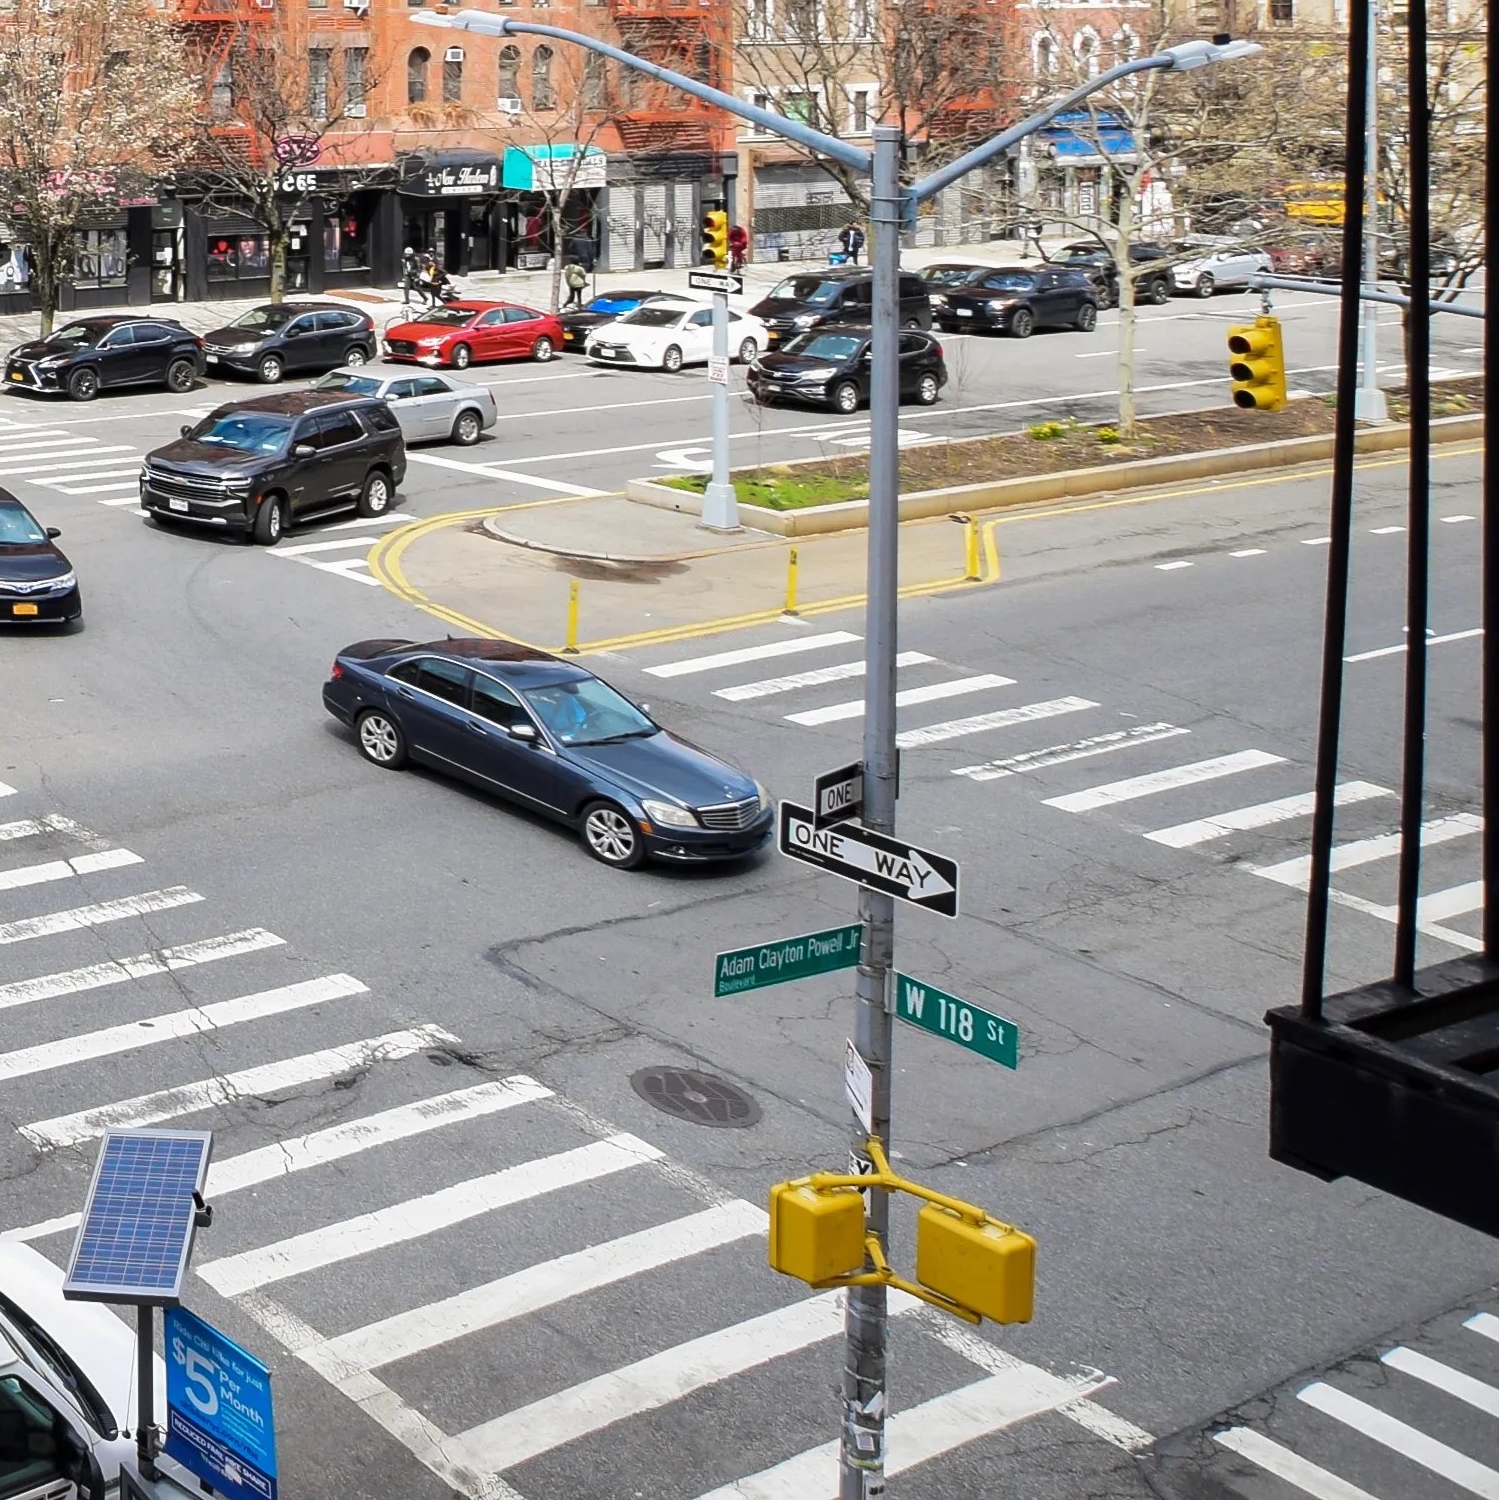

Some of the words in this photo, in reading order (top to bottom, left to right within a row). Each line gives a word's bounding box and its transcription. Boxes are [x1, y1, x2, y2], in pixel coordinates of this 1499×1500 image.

[695, 276, 712, 286] ONE
[719, 280, 735, 289] WAY
[827, 782, 852, 810] ONE
[795, 824, 845, 859] ONE
[874, 850, 932, 889] WAY
[720, 956, 754, 978] Adam
[759, 944, 804, 971] Clayton
[807, 932, 843, 959] Powell
[845, 929, 860, 950] Jr
[719, 975, 756, 992] Boulevard
[905, 982, 926, 1019] W
[938, 998, 974, 1042] 118
[986, 1019, 1005, 1045] St
[173, 1319, 192, 1340] Ride
[232, 1362, 245, 1377] for
[246, 1372, 264, 1392] just
[219, 1370, 241, 1394] Per
[220, 1386, 264, 1428] Month
[174, 1418, 206, 1446] REDUCED
[207, 1441, 224, 1461] FARE
[243, 1469, 268, 1491] SHARE
